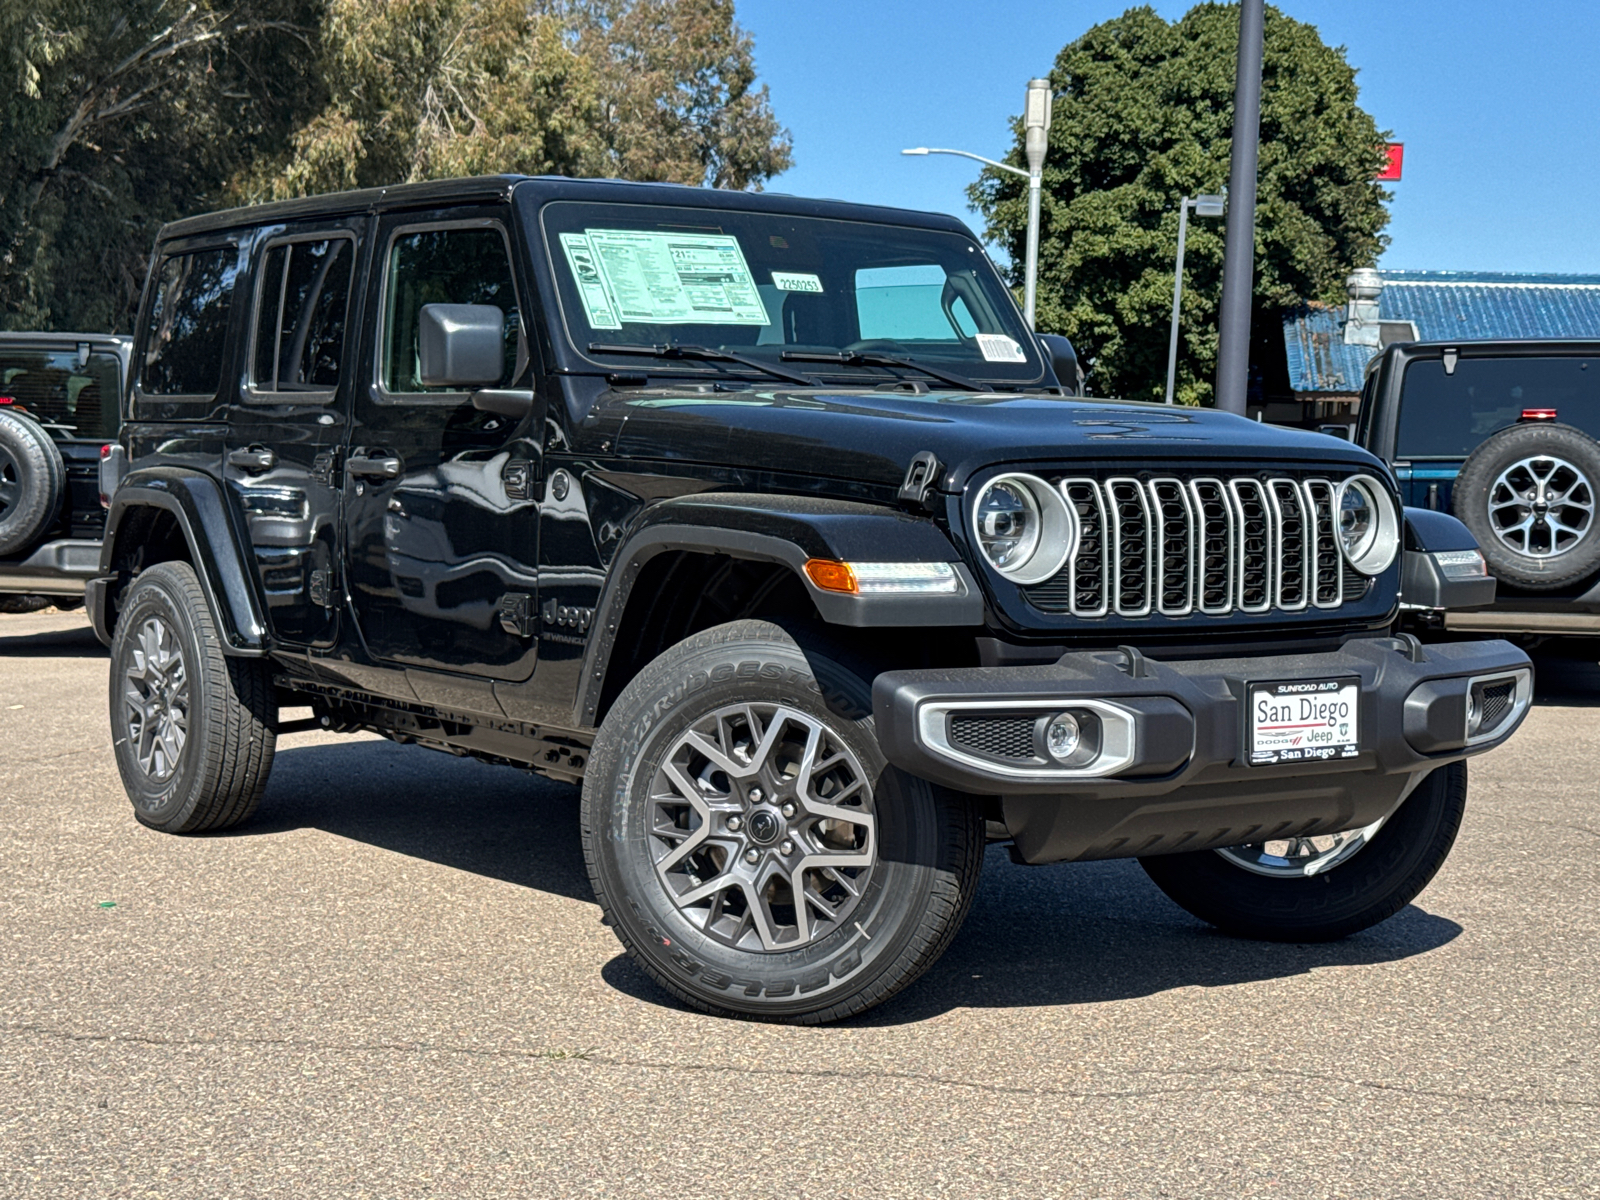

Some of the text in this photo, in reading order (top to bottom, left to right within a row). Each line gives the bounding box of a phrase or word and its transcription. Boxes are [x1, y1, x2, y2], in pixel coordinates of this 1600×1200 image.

[780, 279, 819, 291] 2250253
[543, 598, 590, 633] Jeep
[1278, 682, 1338, 693] SUNROAD AUTO
[1258, 696, 1348, 727] San Diego
[1307, 729, 1333, 743] Jeep
[1281, 750, 1301, 759] San
[1304, 747, 1335, 759] Diego
[670, 947, 863, 998] DUELER
